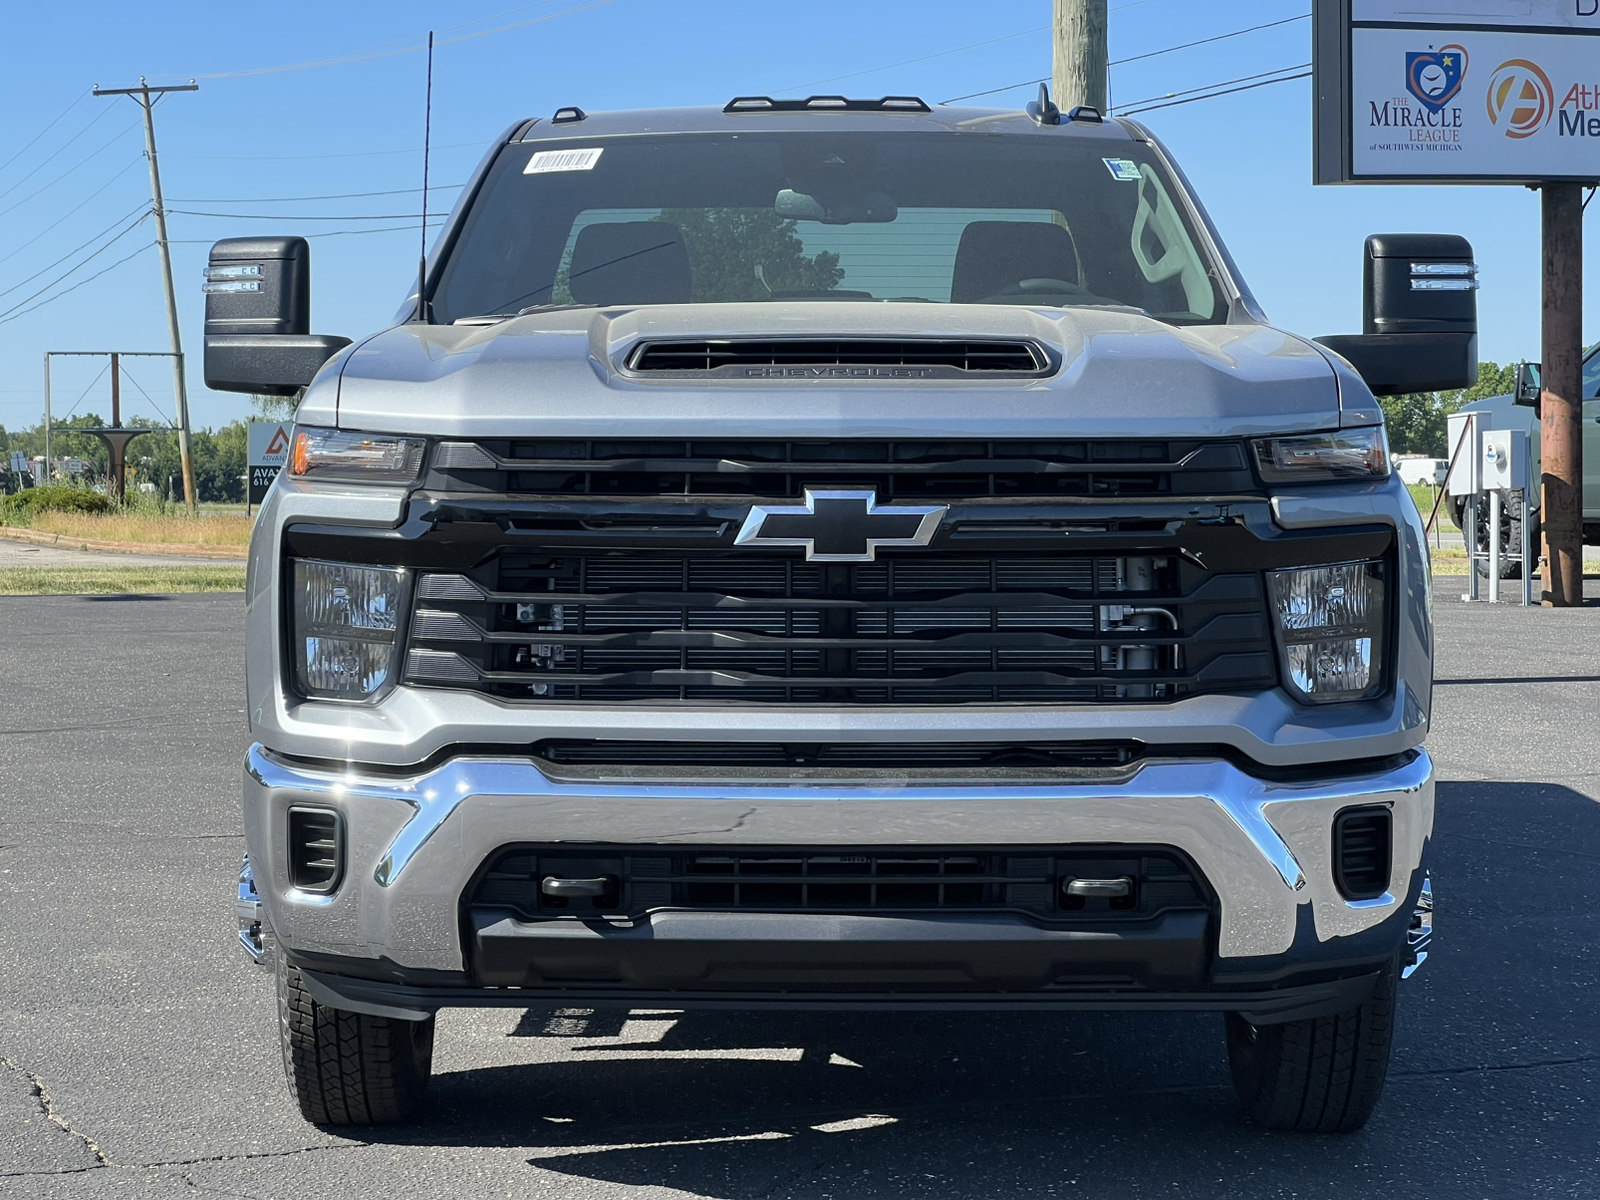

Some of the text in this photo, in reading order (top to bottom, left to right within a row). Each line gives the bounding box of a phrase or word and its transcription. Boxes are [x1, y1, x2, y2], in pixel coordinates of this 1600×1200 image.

[1392, 97, 1409, 106] THE
[1369, 101, 1463, 127] MIRACLE
[1559, 110, 1600, 137] Me
[1409, 129, 1460, 142] LEAGUE
[1369, 143, 1463, 152] of SOUTHWEST MICHIGAN
[746, 367, 929, 378] CHEVROLET
[253, 478, 269, 486] 616
